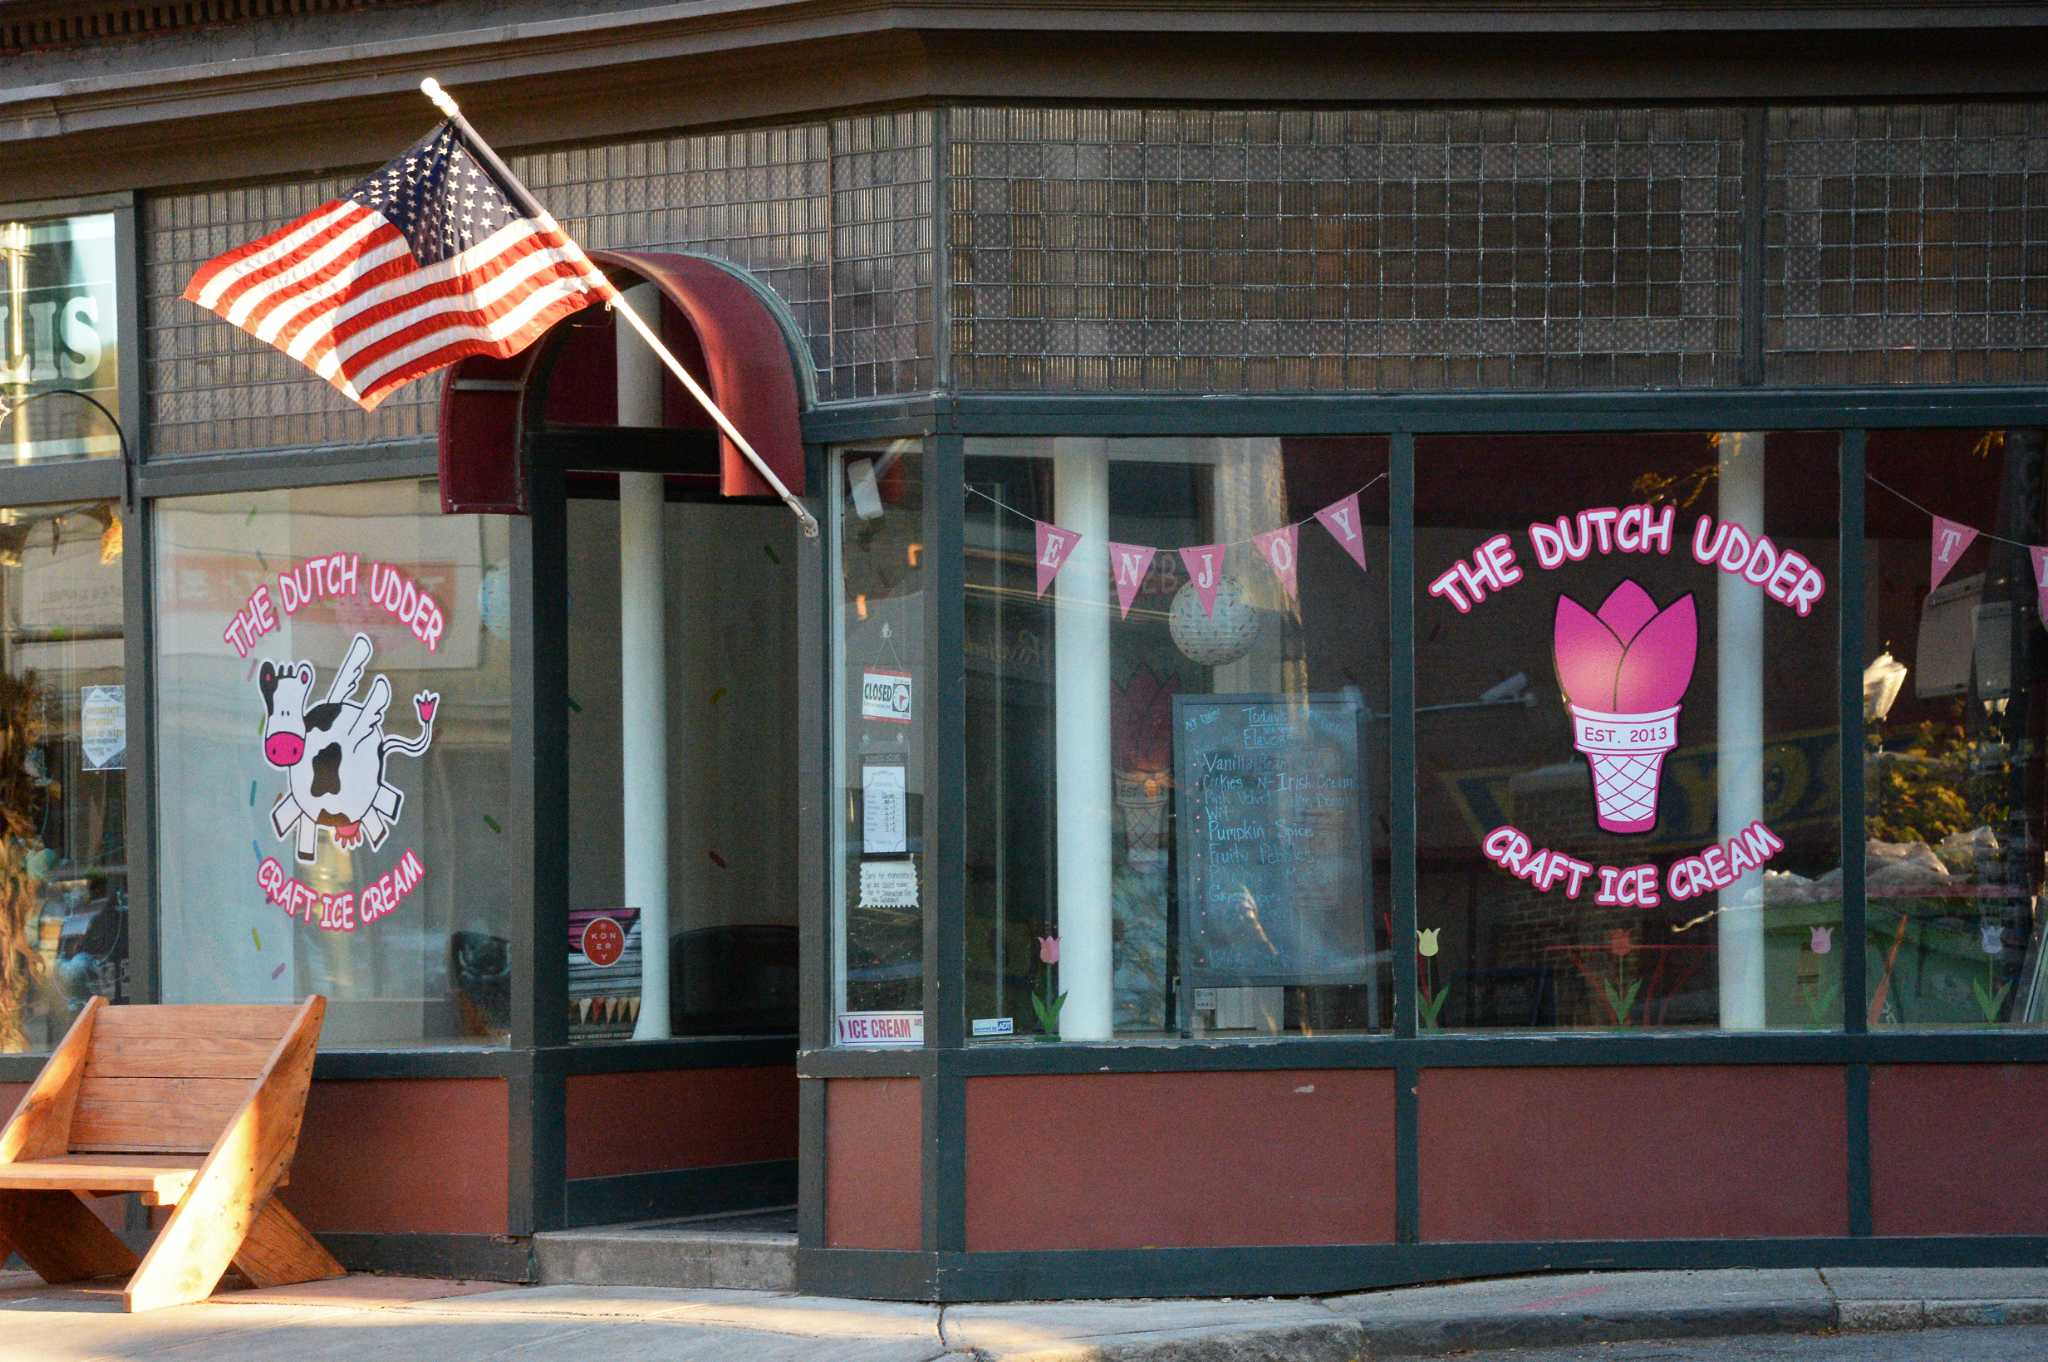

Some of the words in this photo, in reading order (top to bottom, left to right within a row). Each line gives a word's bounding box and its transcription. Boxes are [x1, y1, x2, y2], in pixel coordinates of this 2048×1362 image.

[1429, 534, 1523, 613] THE
[1529, 504, 1676, 570] DUTCH
[1693, 514, 1825, 617] UDDER
[224, 584, 275, 658] THE
[278, 552, 361, 616] DUTCH
[369, 560, 446, 654] UDDER
[864, 682, 892, 702] CLOSED
[1584, 728, 1622, 744] EST.
[1630, 726, 1668, 743] 2013
[1208, 818, 1266, 841] Pumpkin
[257, 856, 318, 925] CRAFT
[319, 893, 356, 932] ICE
[360, 848, 426, 926] CREAM
[1483, 825, 1593, 900] CRAFT
[1596, 864, 1660, 908] ICE
[1668, 820, 1785, 901] CREAM
[848, 1019, 868, 1039] ICE
[871, 1018, 912, 1039] CREAM
